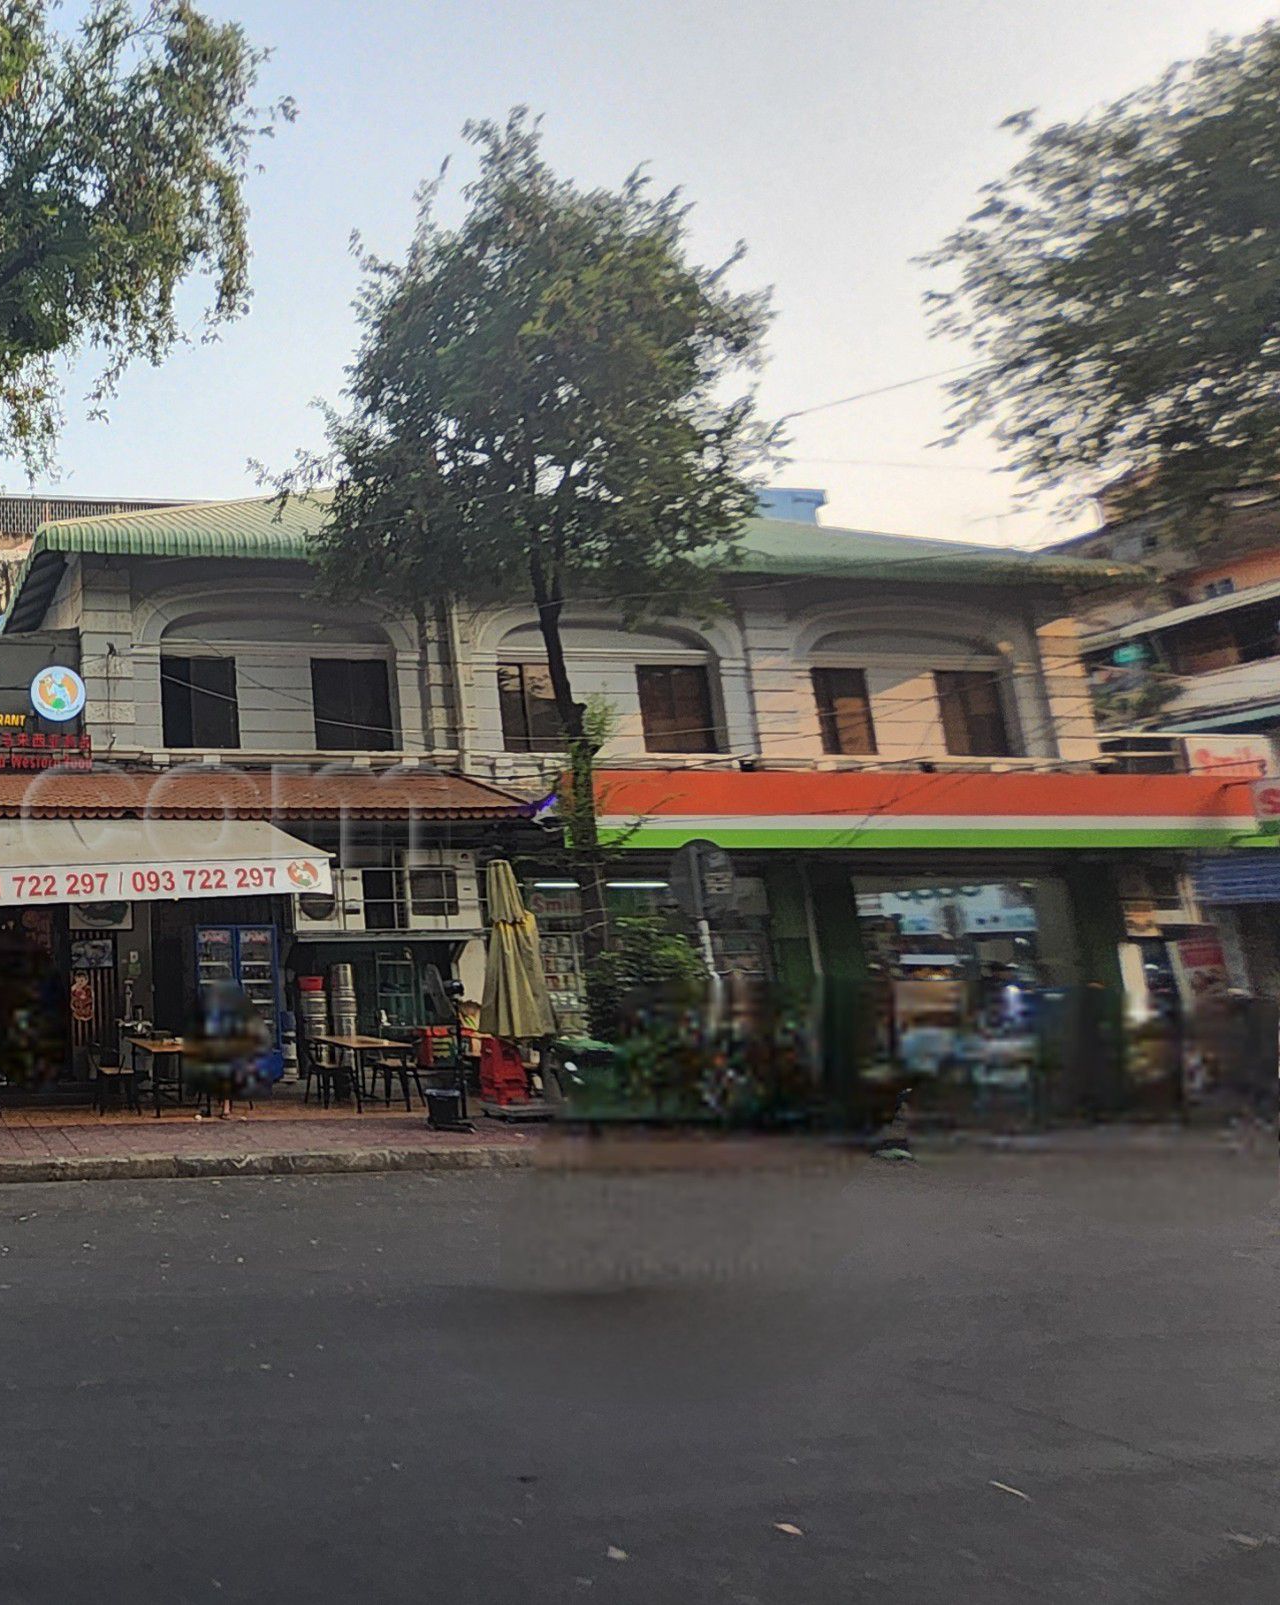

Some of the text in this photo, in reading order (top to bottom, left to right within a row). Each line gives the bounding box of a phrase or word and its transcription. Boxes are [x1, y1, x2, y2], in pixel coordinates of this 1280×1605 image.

[12, 875, 57, 898] 722
[65, 873, 109, 895] 297
[131, 870, 176, 893] 093
[183, 868, 228, 890] 722
[234, 867, 276, 888] 297
